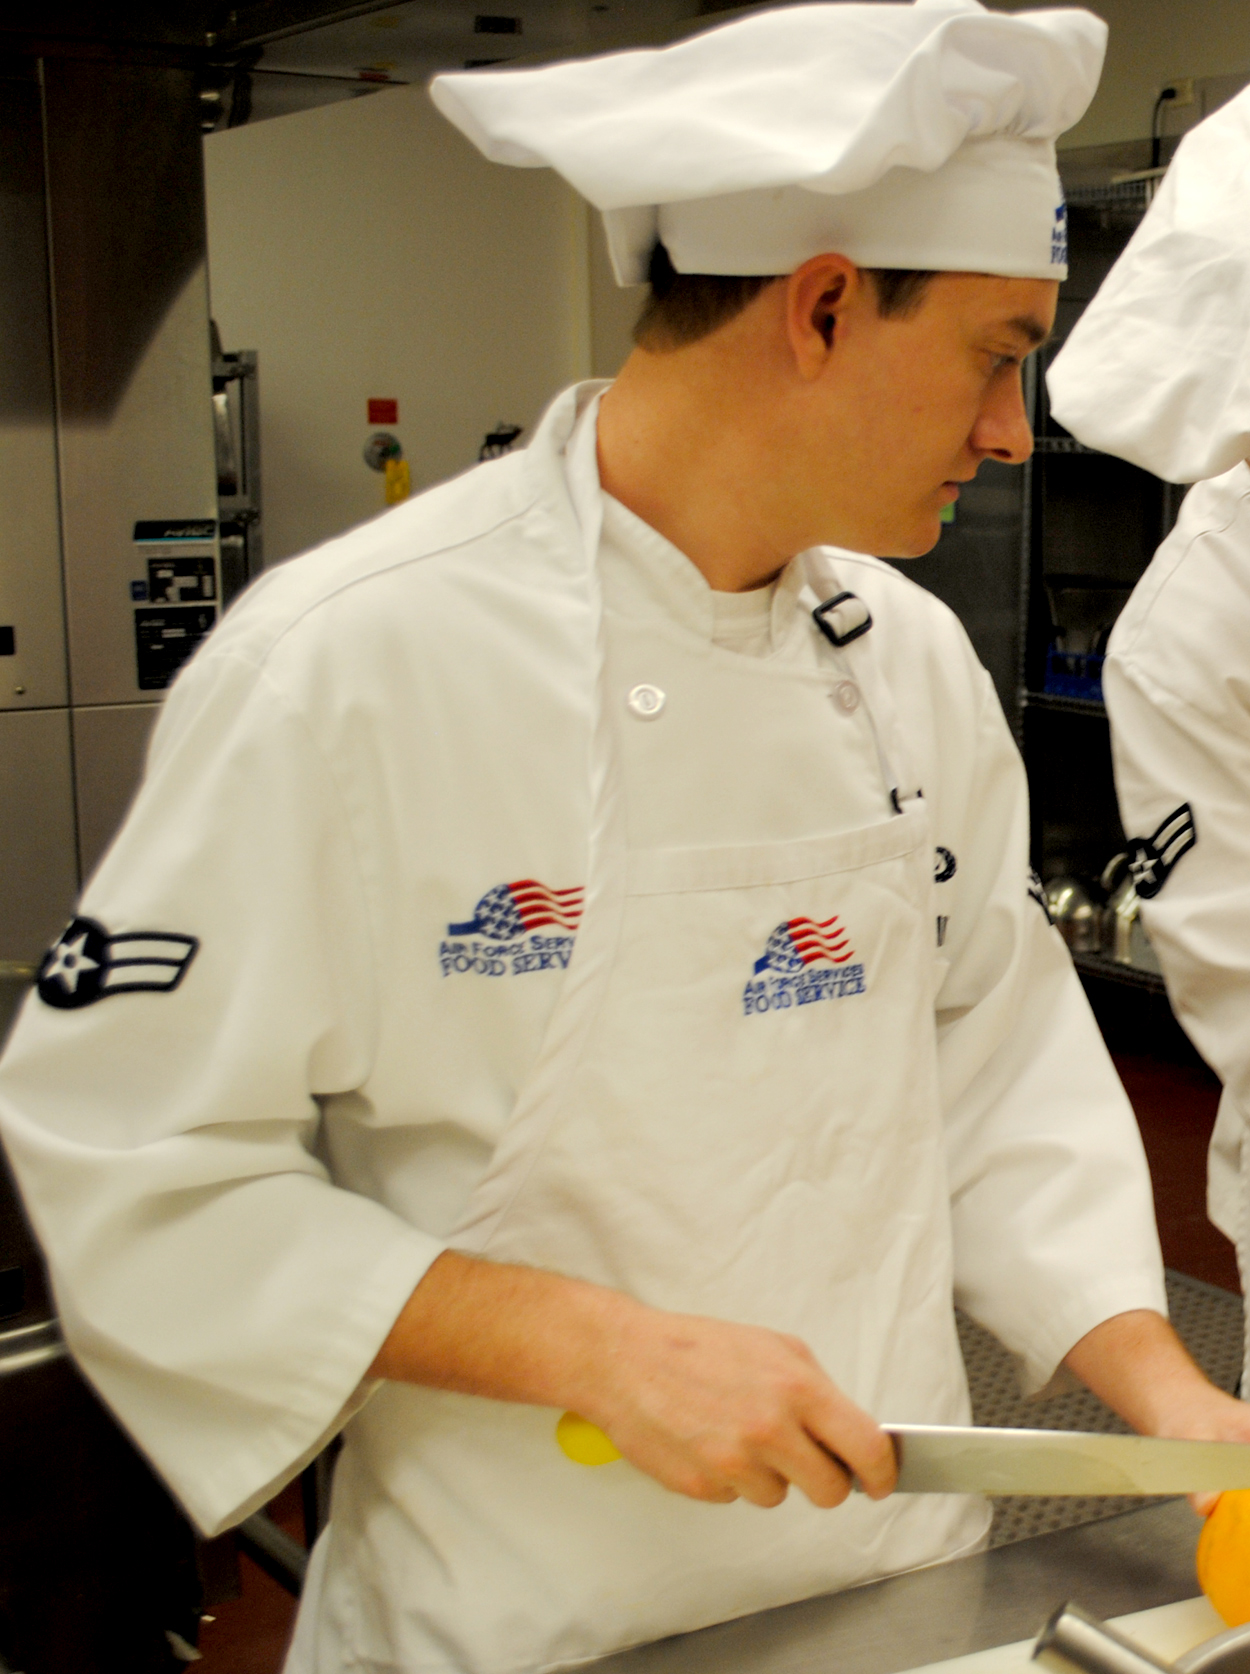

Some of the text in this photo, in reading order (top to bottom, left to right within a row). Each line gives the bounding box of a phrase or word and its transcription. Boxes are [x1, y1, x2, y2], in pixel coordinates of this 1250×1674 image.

[440, 941, 467, 957] AIR
[471, 941, 525, 957] FORCE
[440, 954, 507, 978] FOOD
[743, 976, 867, 1016] FOOD SERVICE
